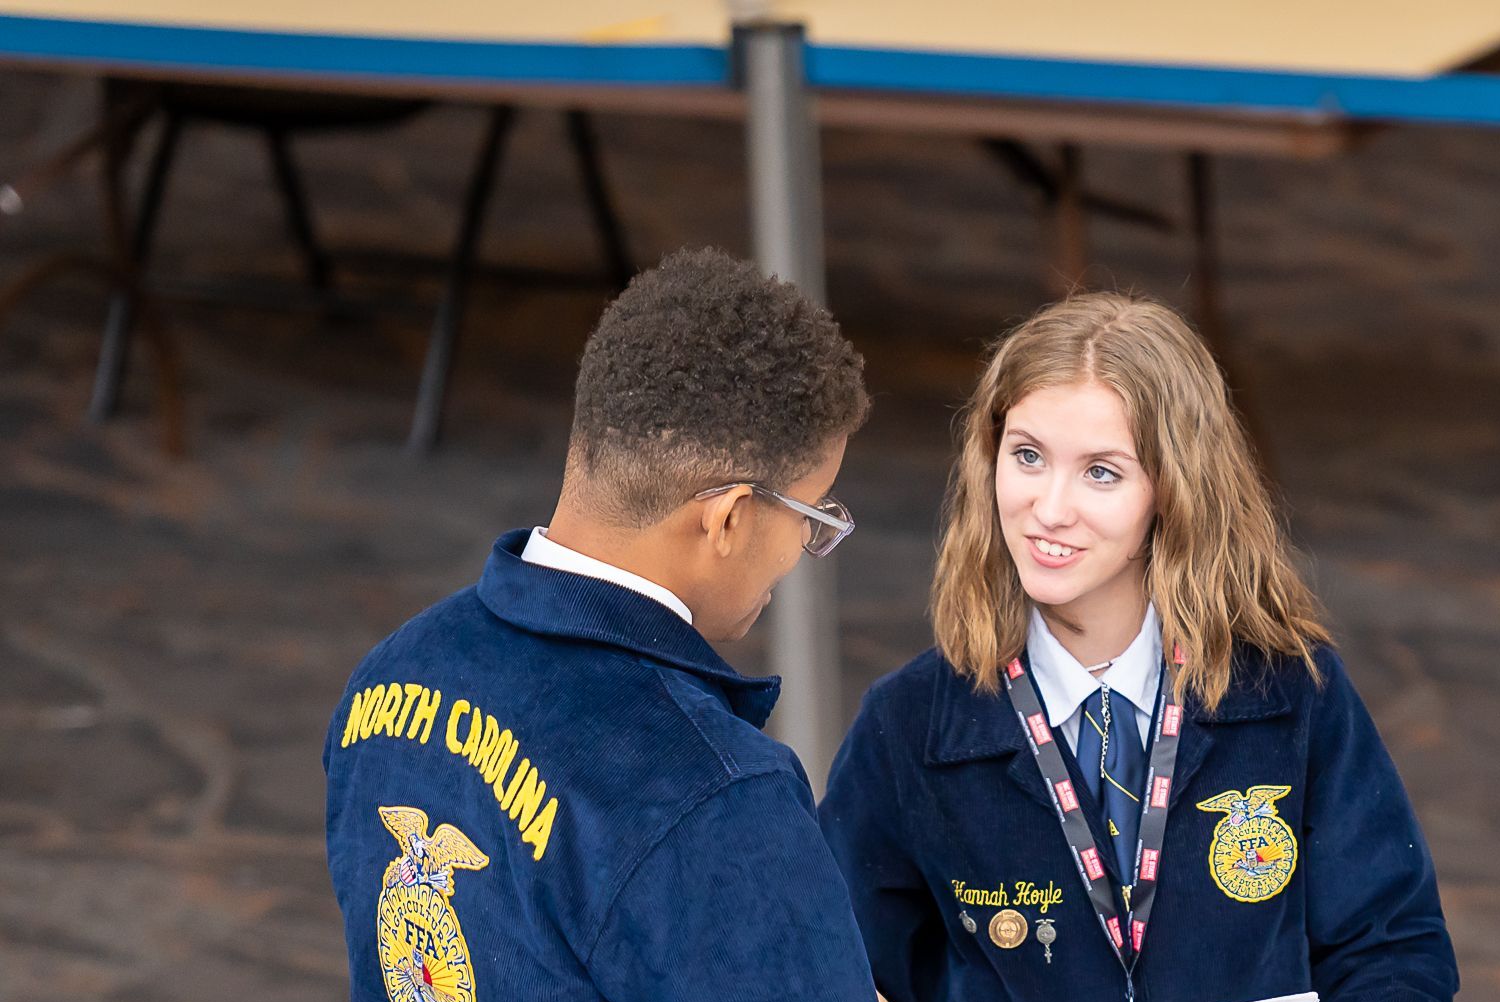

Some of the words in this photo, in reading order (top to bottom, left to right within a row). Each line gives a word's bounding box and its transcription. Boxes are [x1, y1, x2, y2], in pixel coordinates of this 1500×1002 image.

[341, 682, 441, 748] NORTH
[446, 699, 558, 861] CAROLINA
[1238, 836, 1269, 852] FFA
[951, 879, 1008, 906] Hannah
[1013, 880, 1064, 914] Hoyle
[404, 917, 440, 960] FFA
